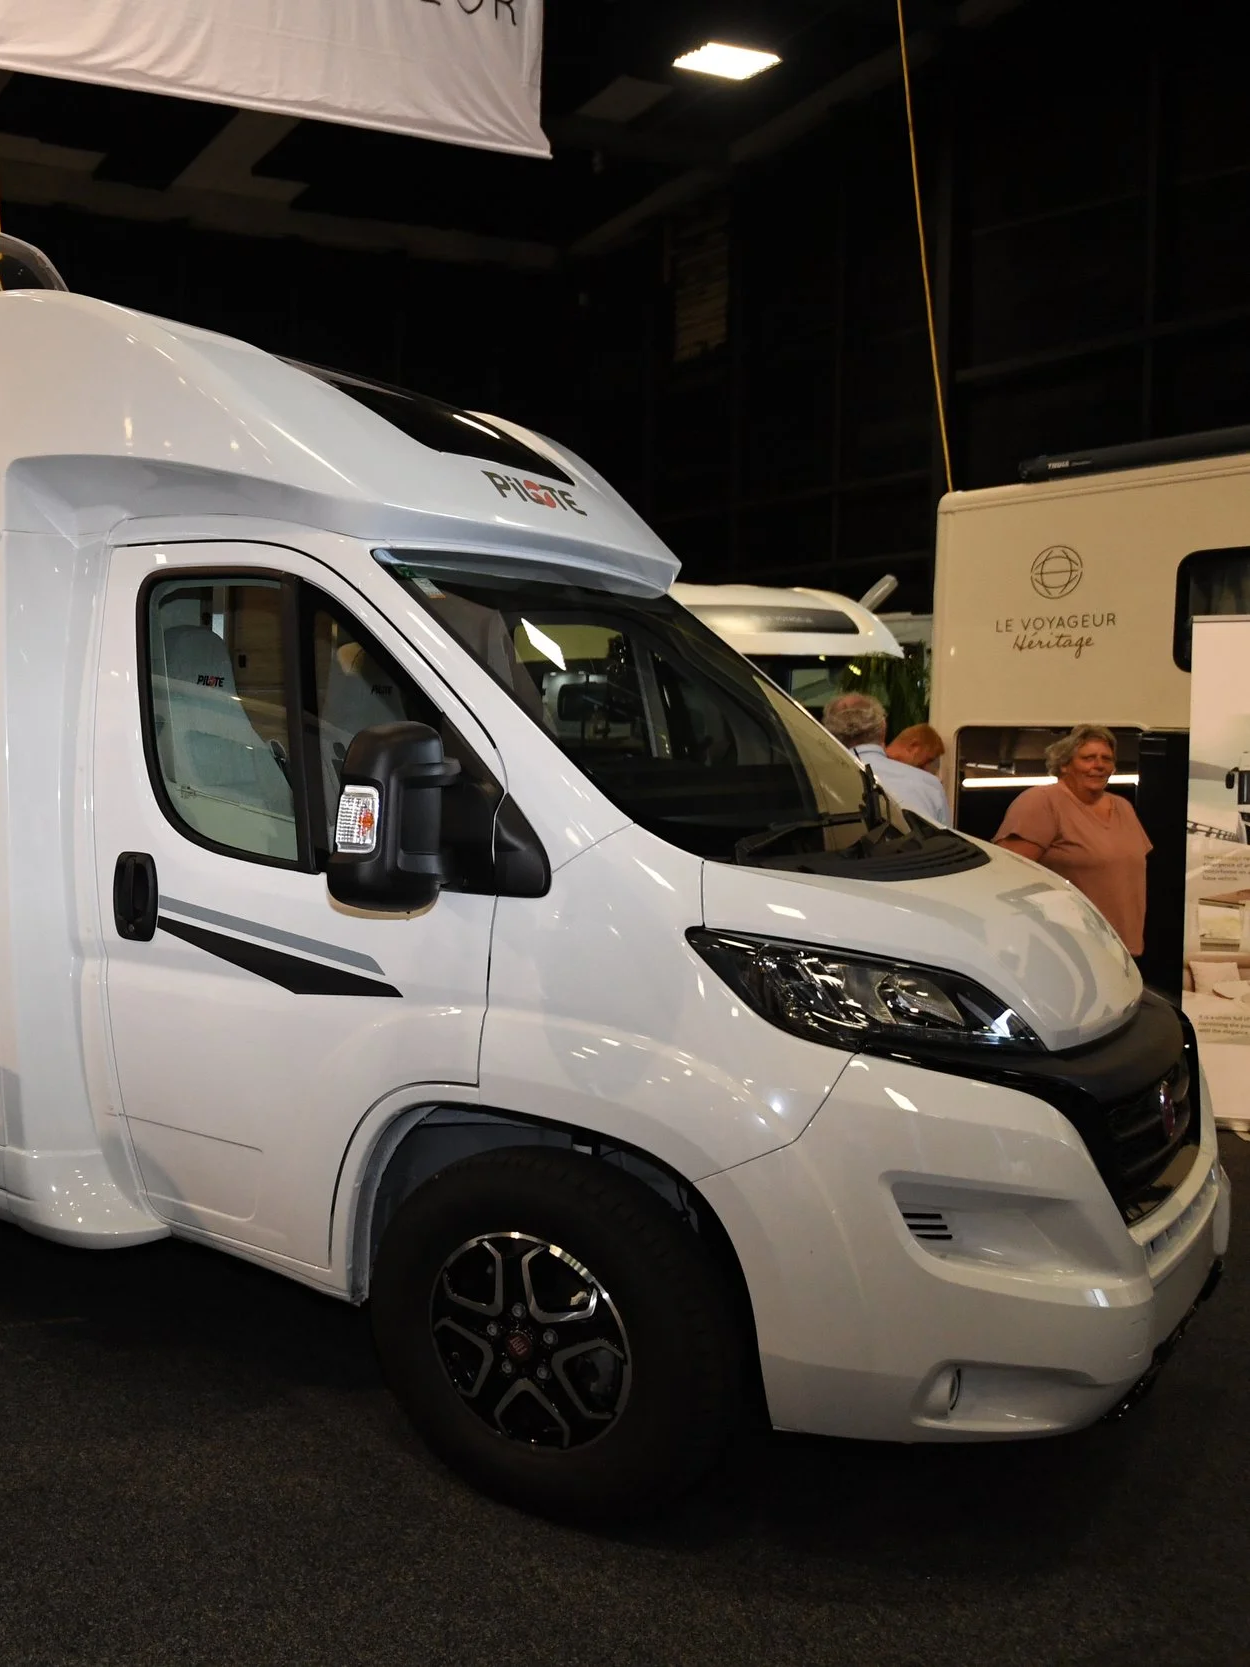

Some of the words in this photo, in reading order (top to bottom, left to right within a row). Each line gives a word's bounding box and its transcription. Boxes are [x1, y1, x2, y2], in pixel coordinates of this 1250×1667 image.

[995, 619, 1014, 633] LE
[1021, 612, 1117, 631] VOYAGEUR
[1012, 631, 1095, 659] Héritage
